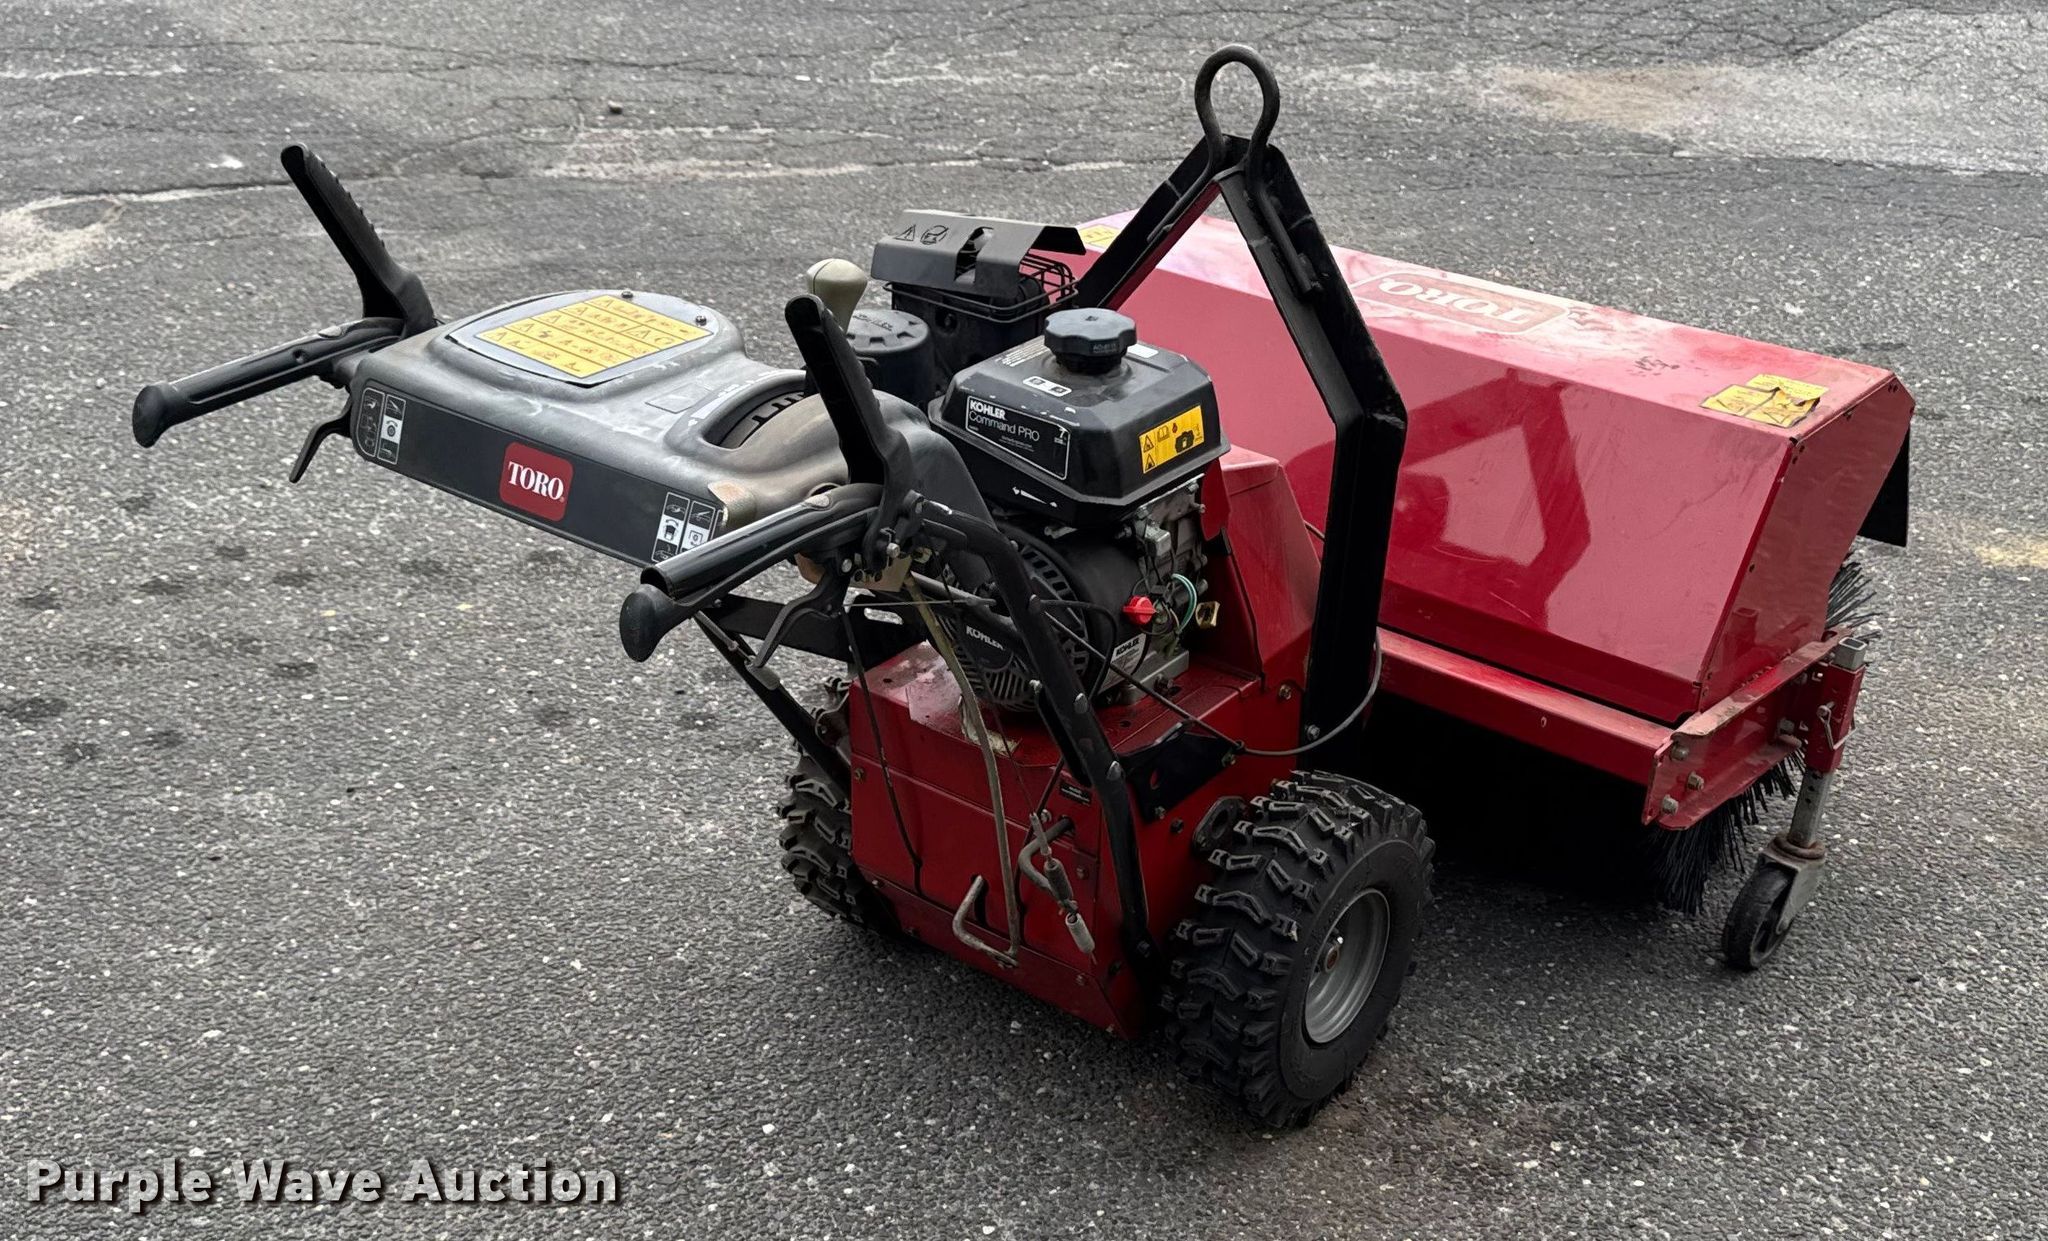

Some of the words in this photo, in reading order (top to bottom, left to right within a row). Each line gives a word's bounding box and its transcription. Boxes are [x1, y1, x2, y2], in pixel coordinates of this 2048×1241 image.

[1379, 279, 1530, 324] TORO
[970, 400, 1006, 420] KOHLER
[969, 410, 1016, 434] Command
[1017, 426, 1040, 442] PRO
[508, 461, 564, 501] TORO
[966, 625, 1004, 651] KOHLER
[1115, 637, 1140, 656] KOHLER
